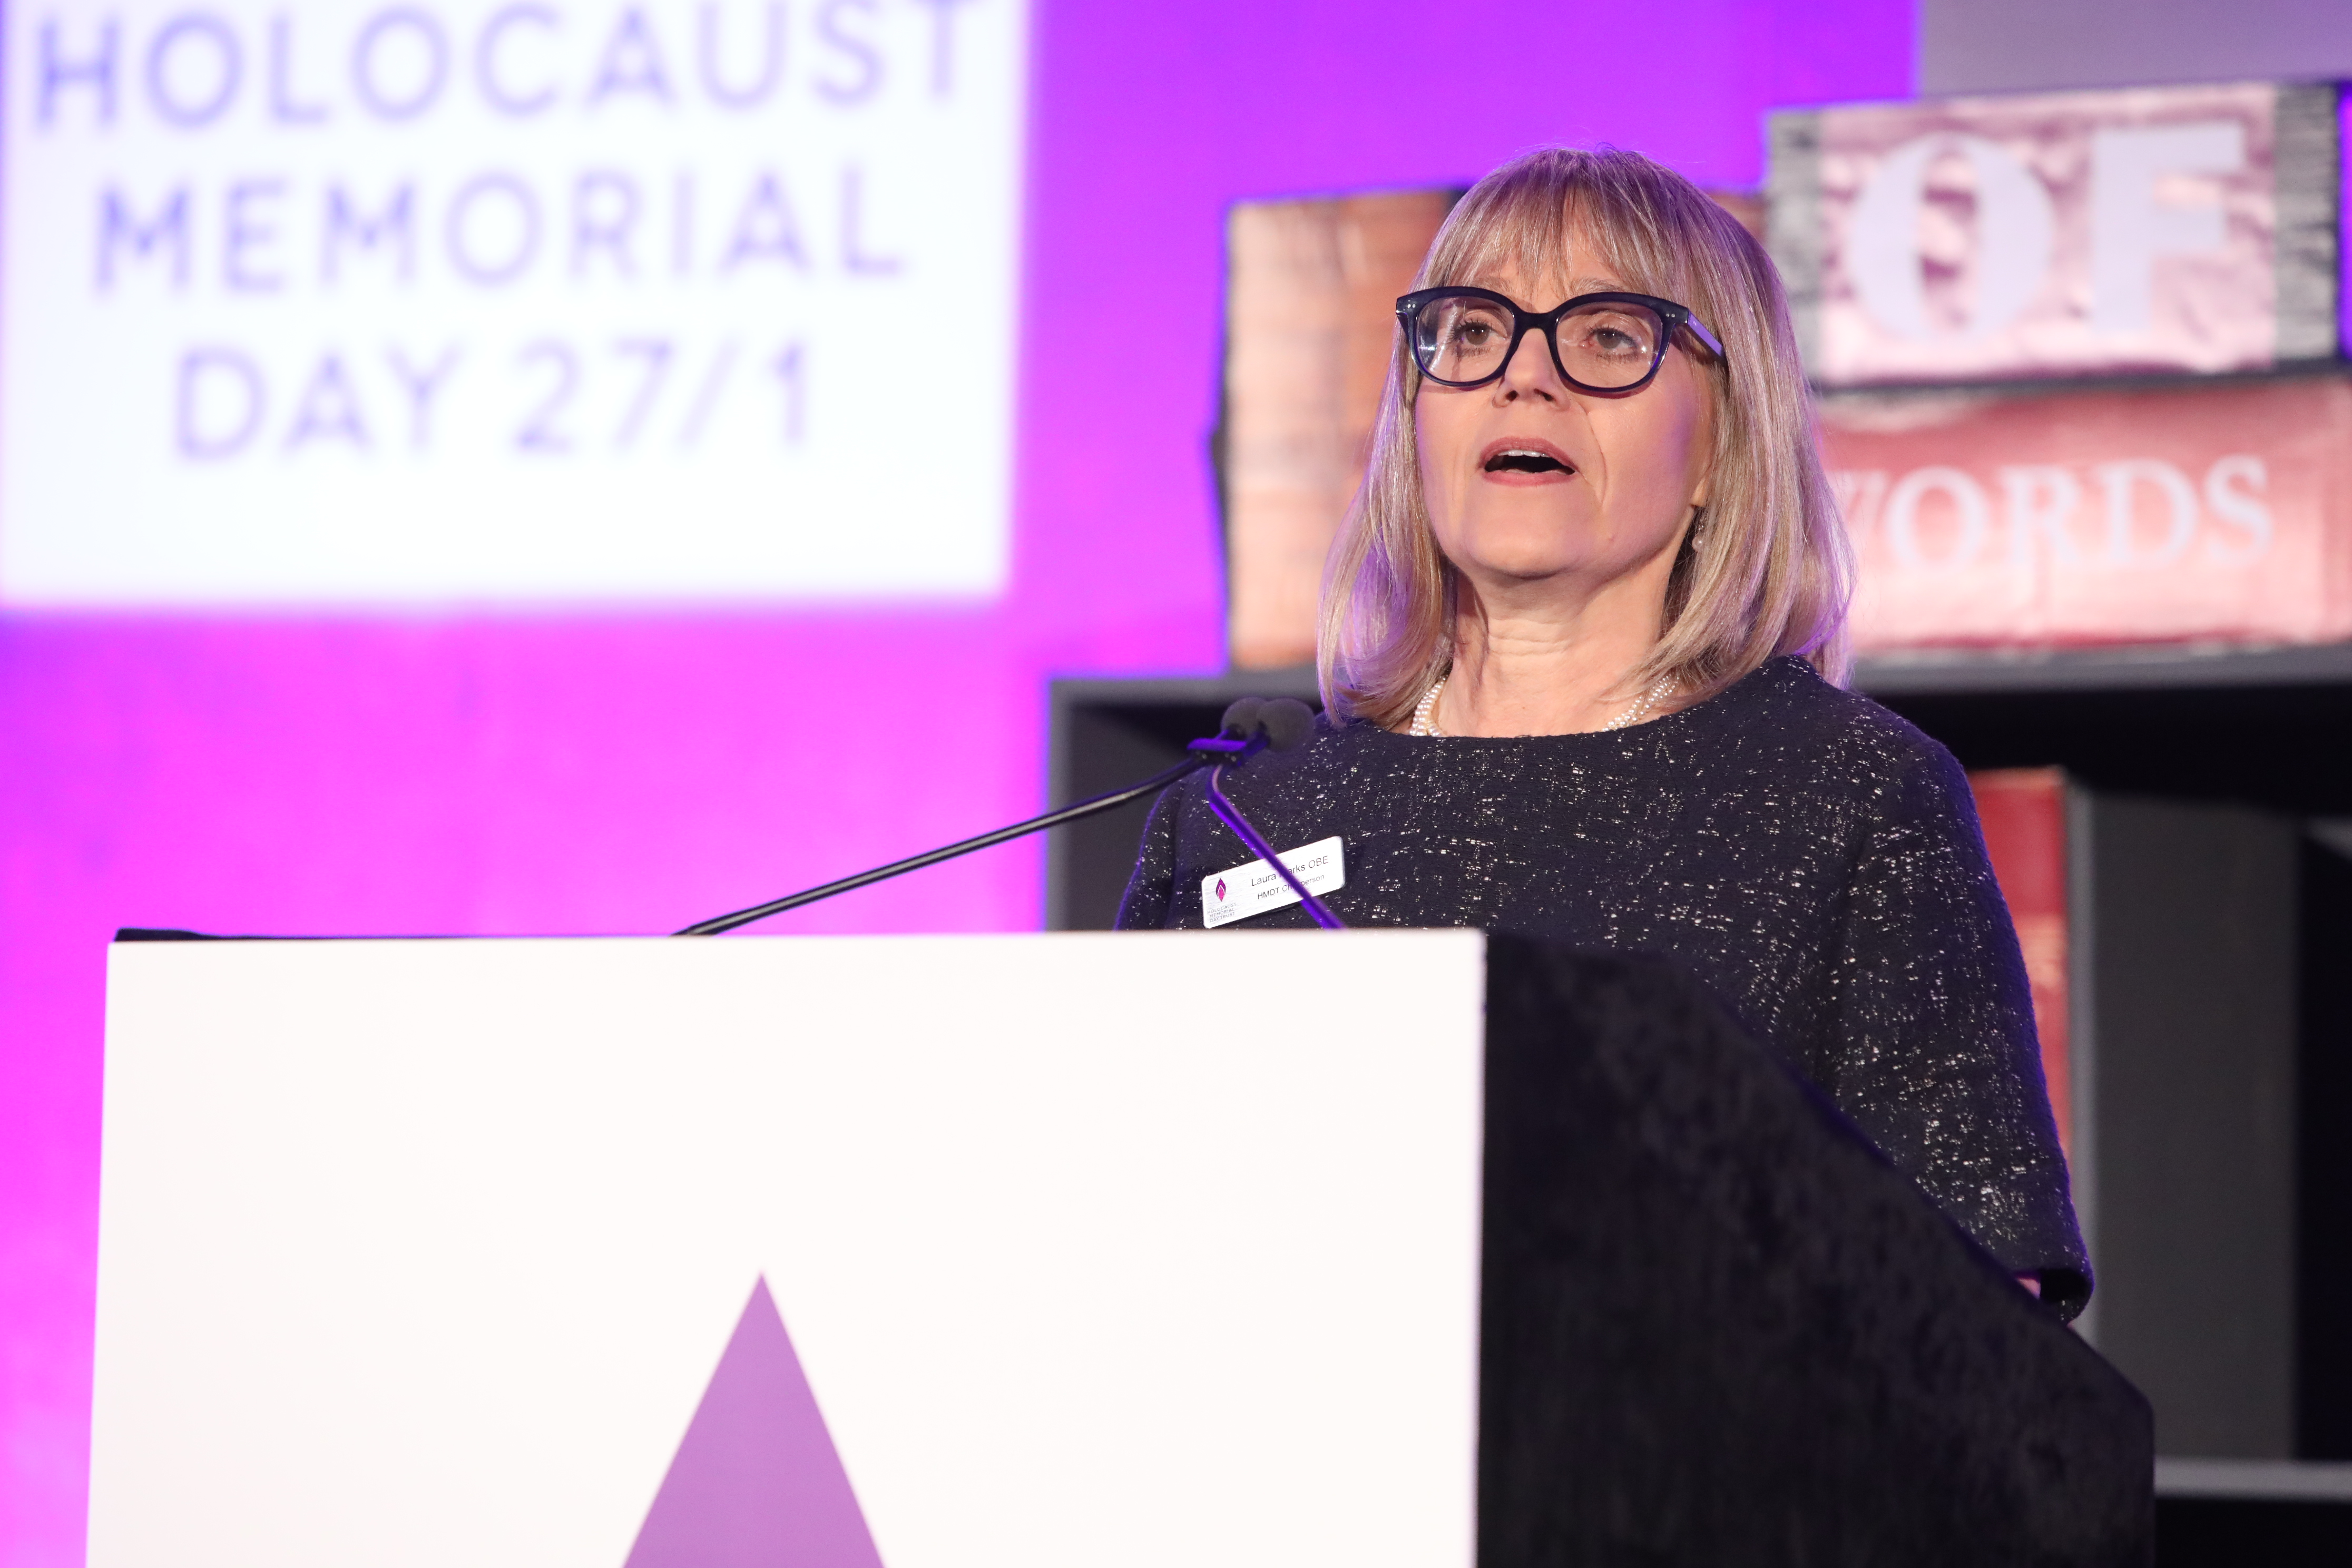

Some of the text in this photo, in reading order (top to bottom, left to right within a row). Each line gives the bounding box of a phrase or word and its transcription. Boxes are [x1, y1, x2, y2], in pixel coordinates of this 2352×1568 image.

[33, 0, 976, 133] HOLOCAUST
[95, 164, 907, 296] MEMORIAL
[1842, 119, 2246, 345] OF
[173, 335, 809, 465] DAY 27/1
[1207, 902, 1237, 915] HOLOCAUST
[1251, 874, 1276, 886] Laura
[1308, 856, 1329, 868] OBE
[1257, 875, 1325, 899] HMDT Chperson
[1209, 908, 1235, 918] MEMORIAL
